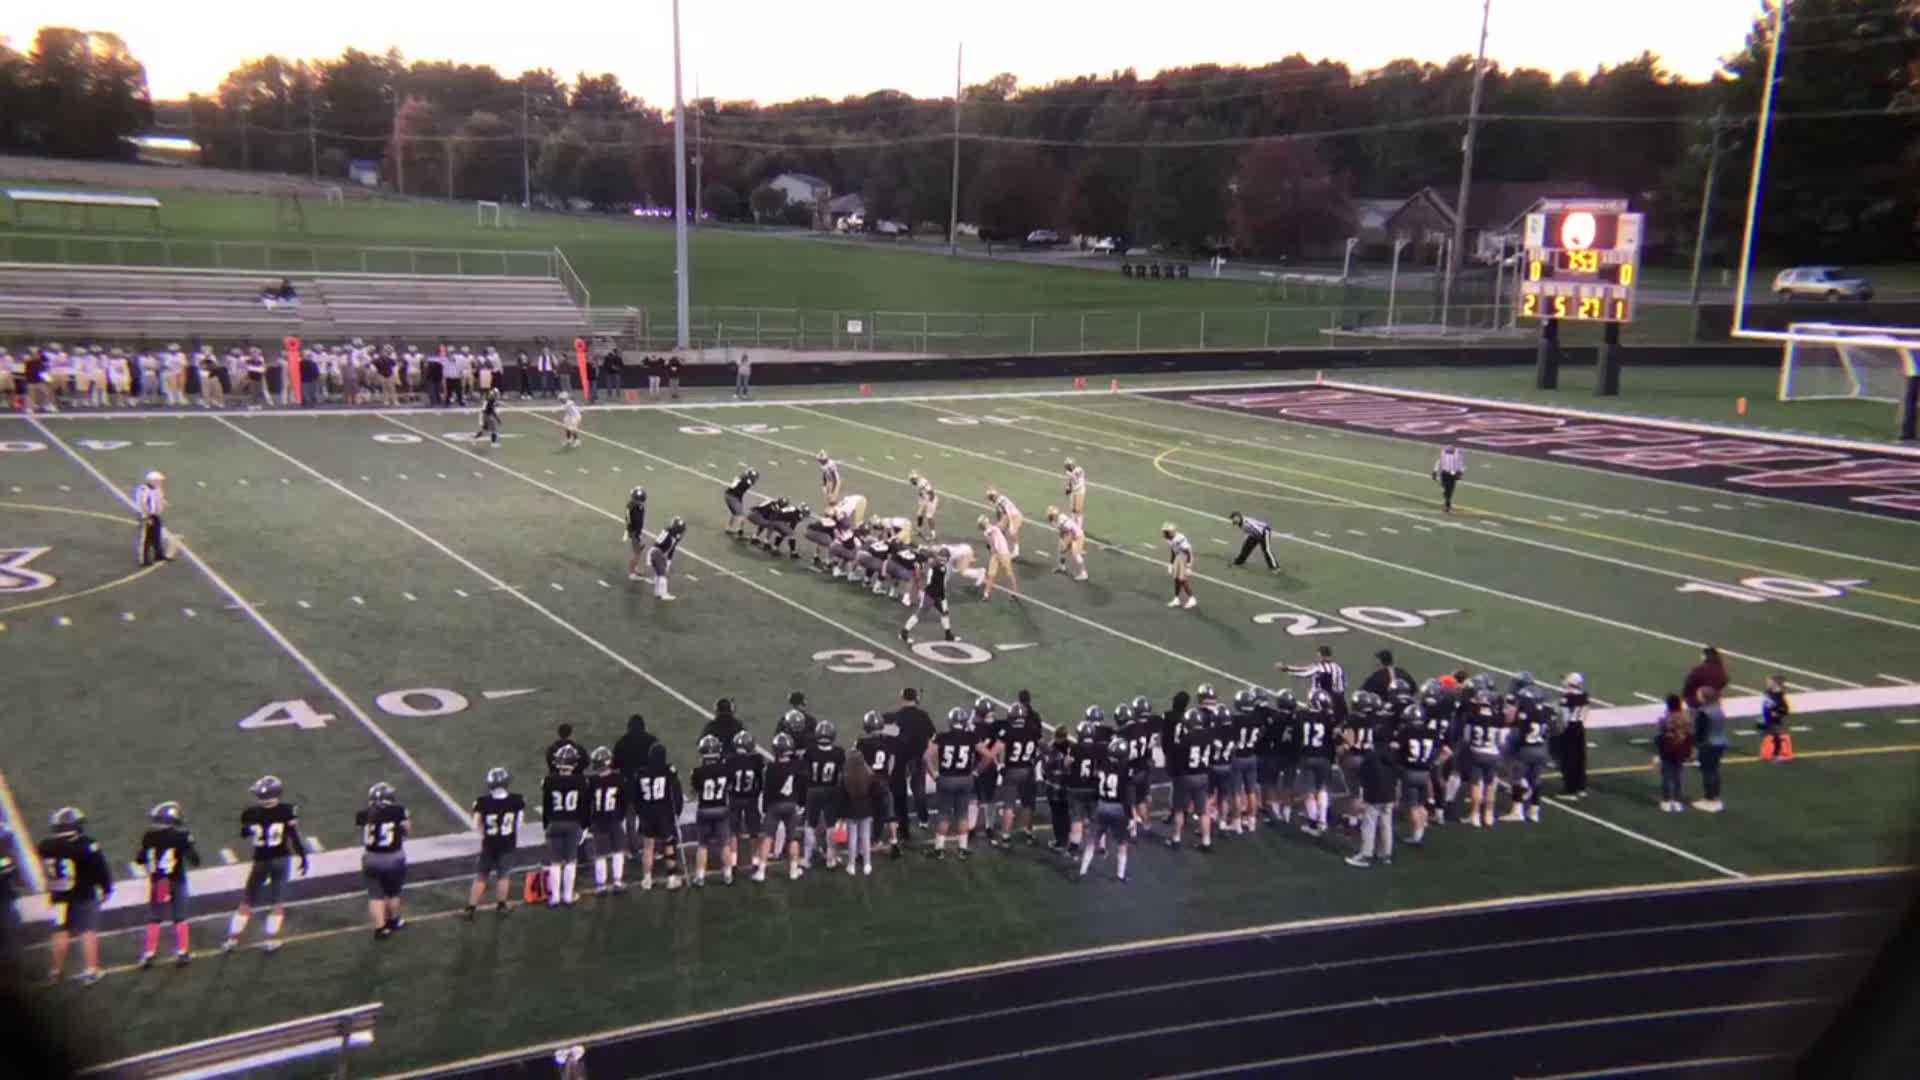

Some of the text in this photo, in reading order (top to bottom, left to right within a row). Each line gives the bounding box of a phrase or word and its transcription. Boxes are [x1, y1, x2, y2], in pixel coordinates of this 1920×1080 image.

[1530, 261, 1541, 281] 0
[1620, 264, 1632, 285] 0
[1523, 294, 1536, 315] 2
[1555, 296, 1566, 317] 5
[1578, 297, 1600, 319] 27
[812, 640, 992, 673] 30
[1303, 722, 1325, 747] 12
[941, 745, 970, 768] 55
